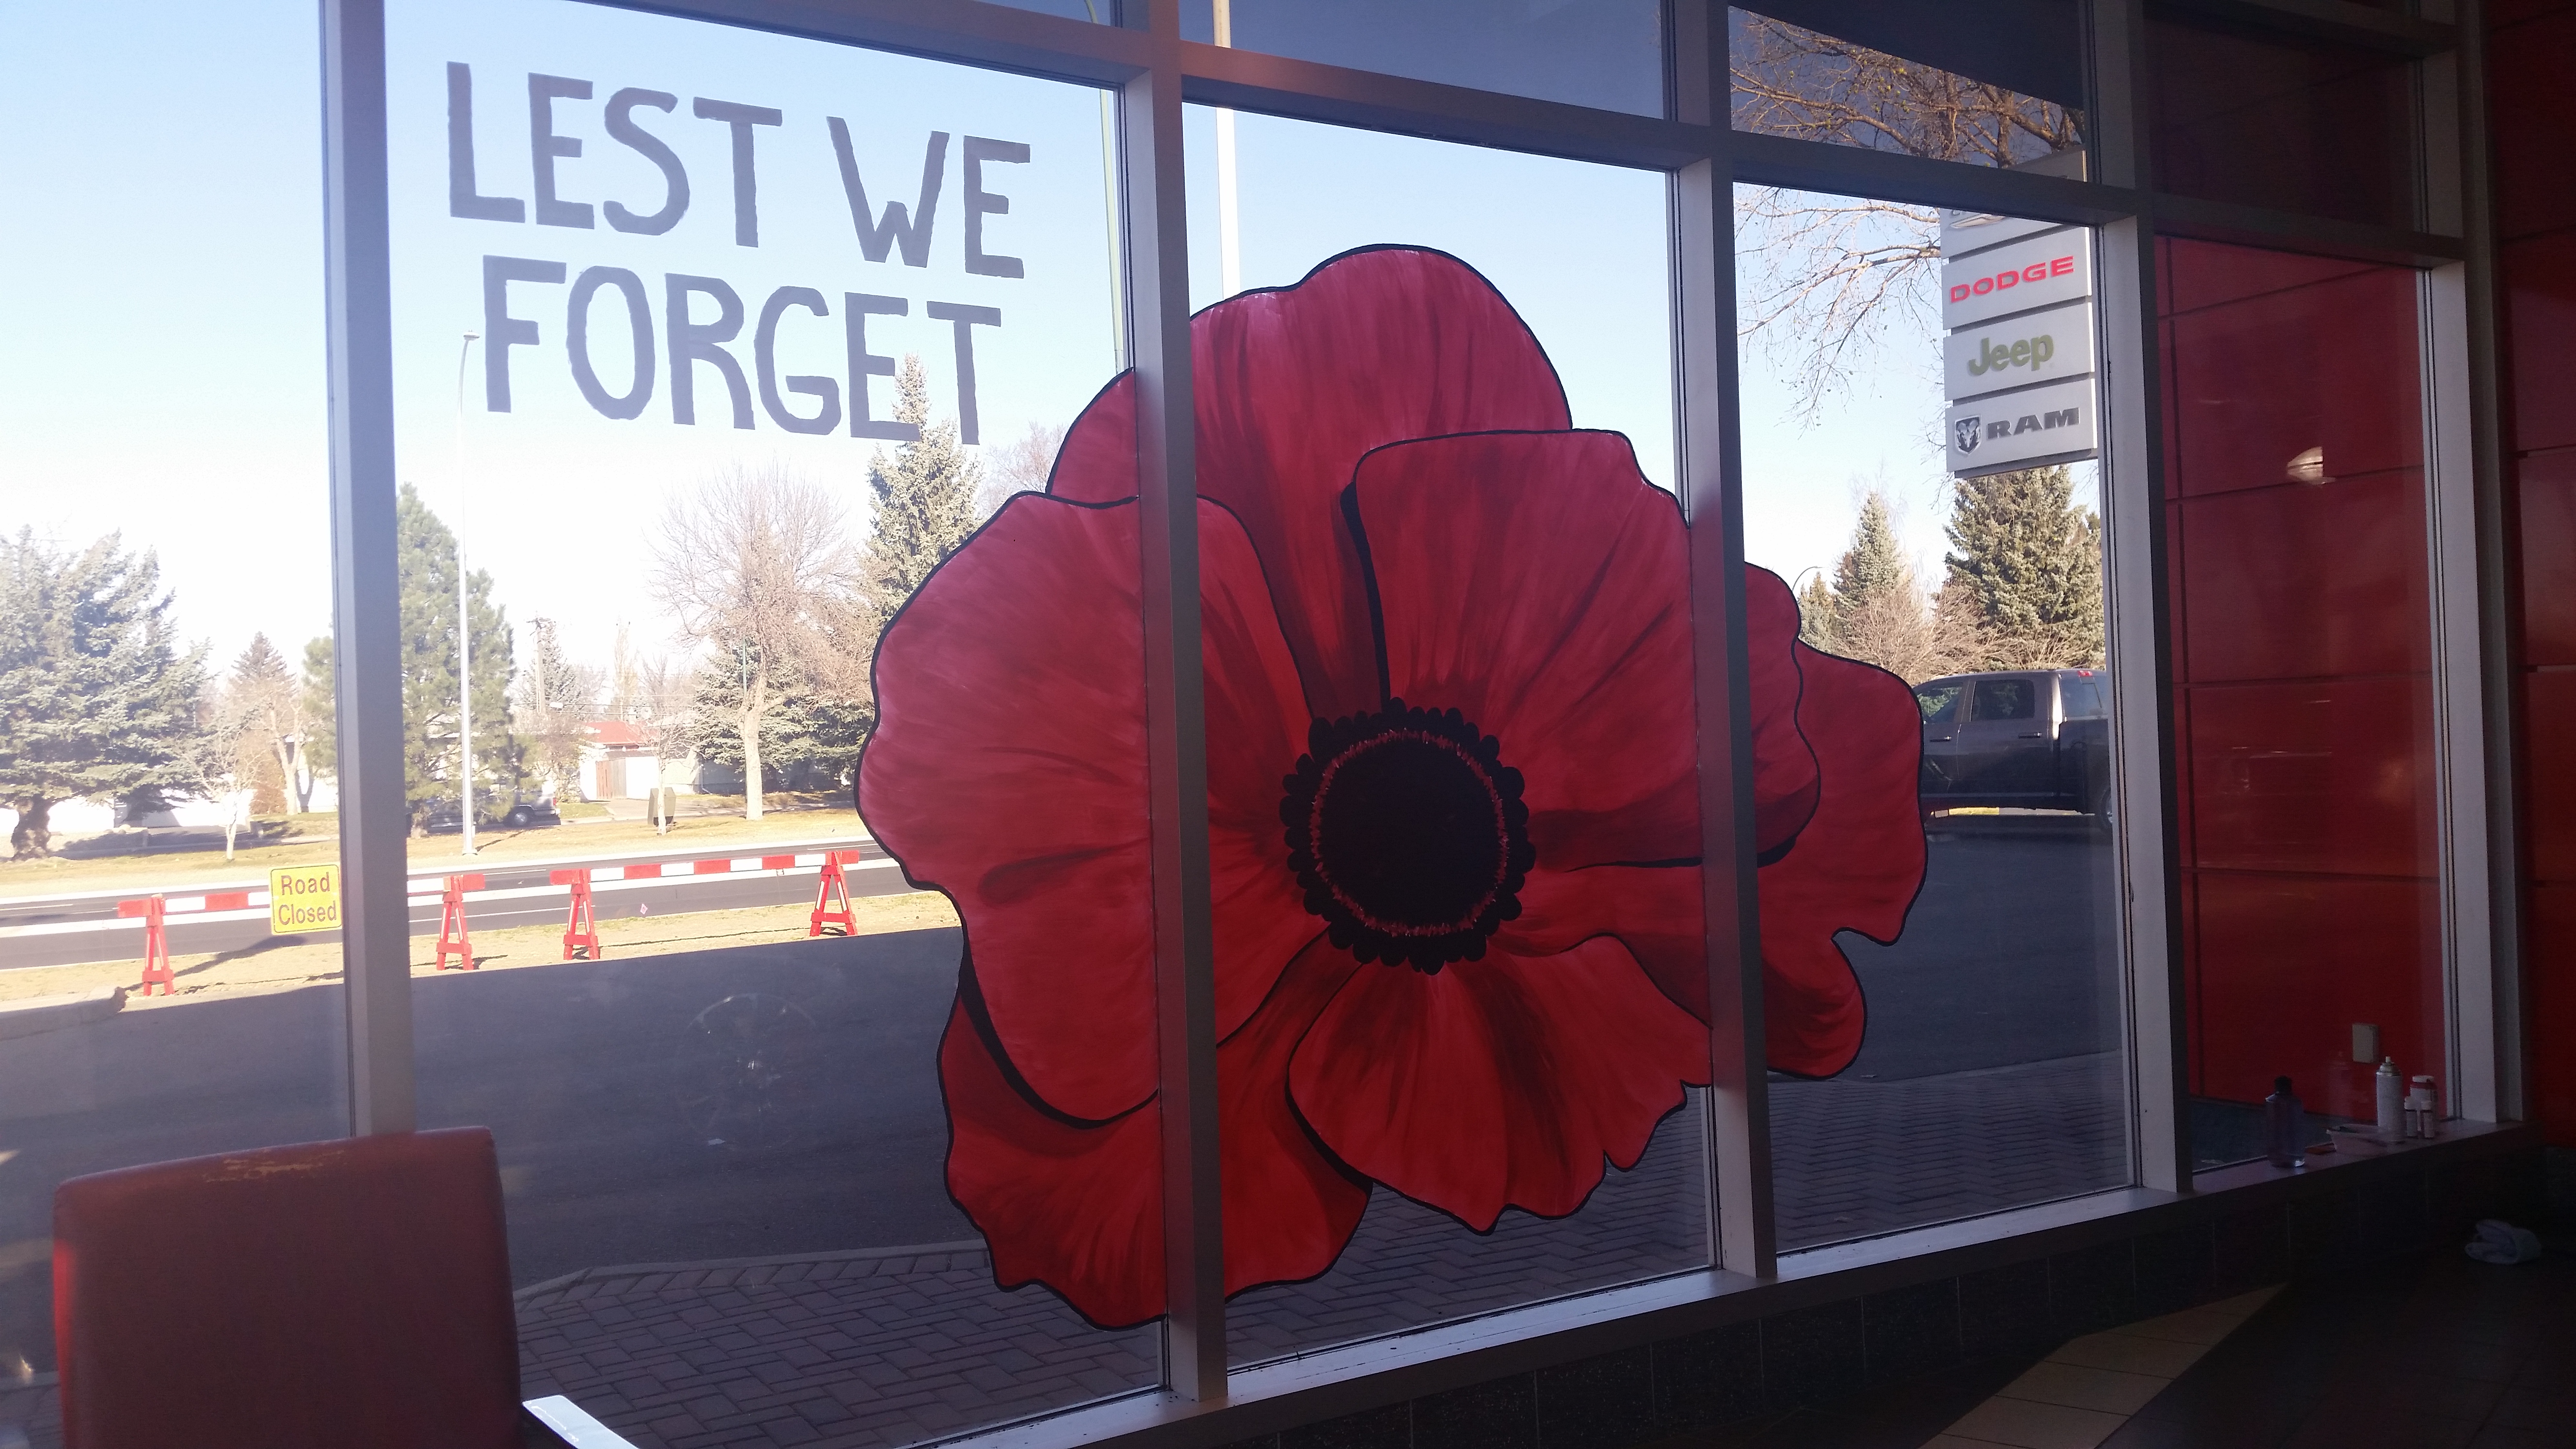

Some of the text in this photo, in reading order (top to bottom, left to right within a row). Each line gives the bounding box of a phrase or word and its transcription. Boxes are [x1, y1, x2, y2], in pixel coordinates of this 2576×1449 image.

[447, 61, 1030, 279] LEST WE
[1950, 255, 2075, 304] DODGE
[483, 255, 1001, 445] FORGET
[1968, 334, 2055, 376] Jeep
[1986, 407, 2079, 440] RAM
[280, 871, 330, 895] Road
[278, 900, 337, 925] Closed
